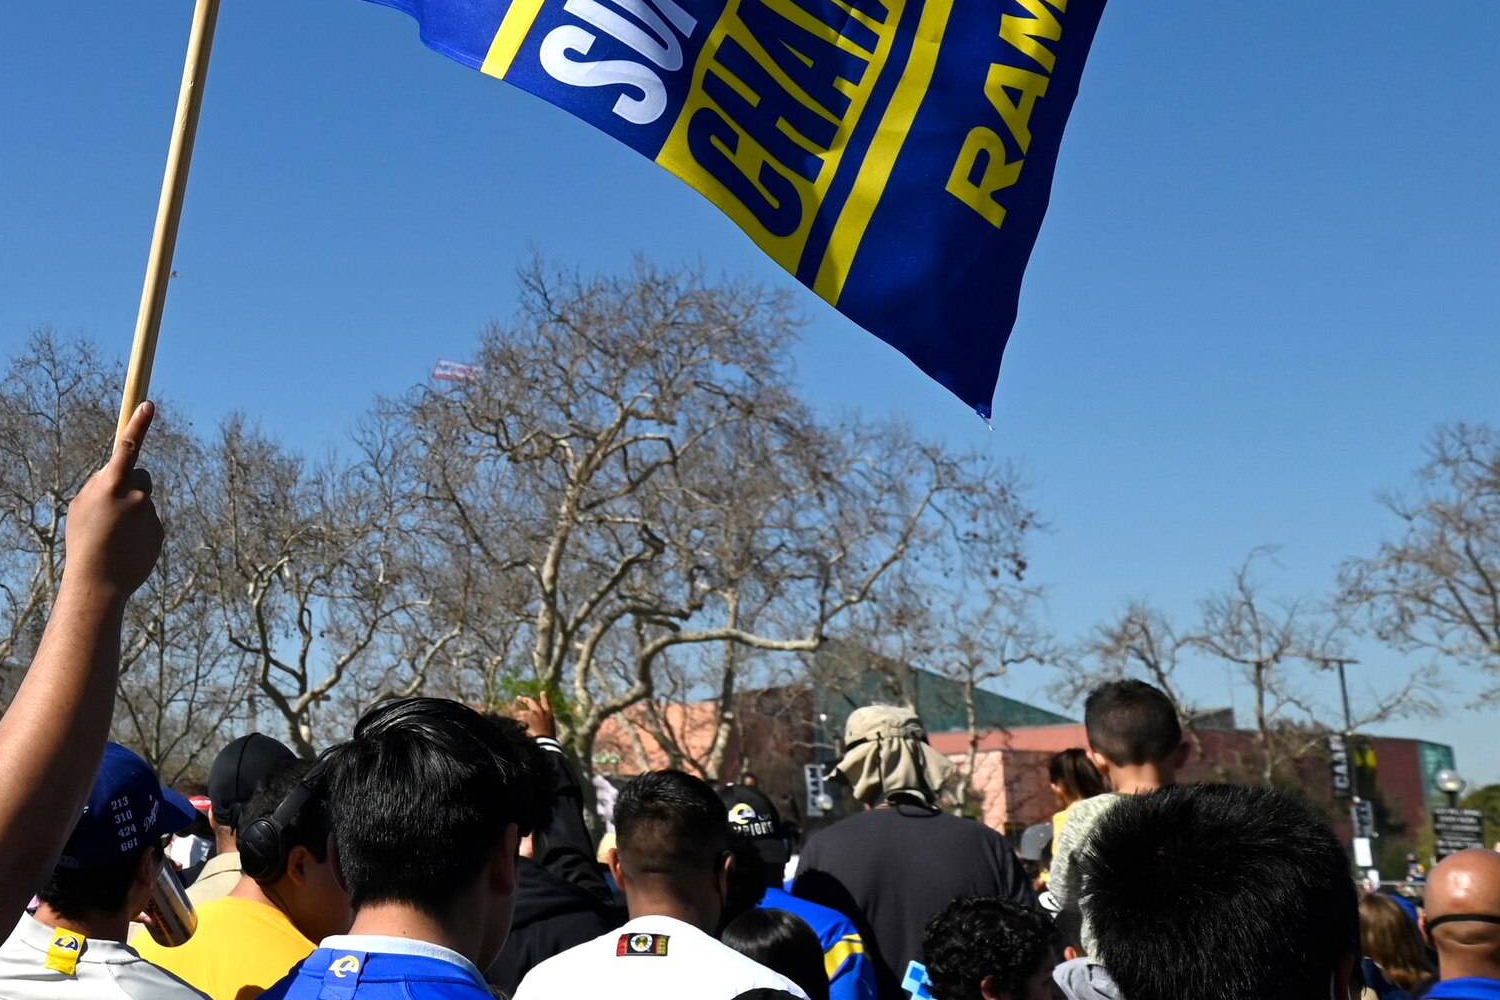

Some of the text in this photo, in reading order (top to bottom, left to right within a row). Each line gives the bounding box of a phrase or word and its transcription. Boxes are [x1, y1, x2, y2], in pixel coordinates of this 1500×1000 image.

[111, 796, 129, 811] 213
[114, 810, 133, 824] 310
[118, 824, 137, 838] 424
[120, 838, 139, 852] 661
